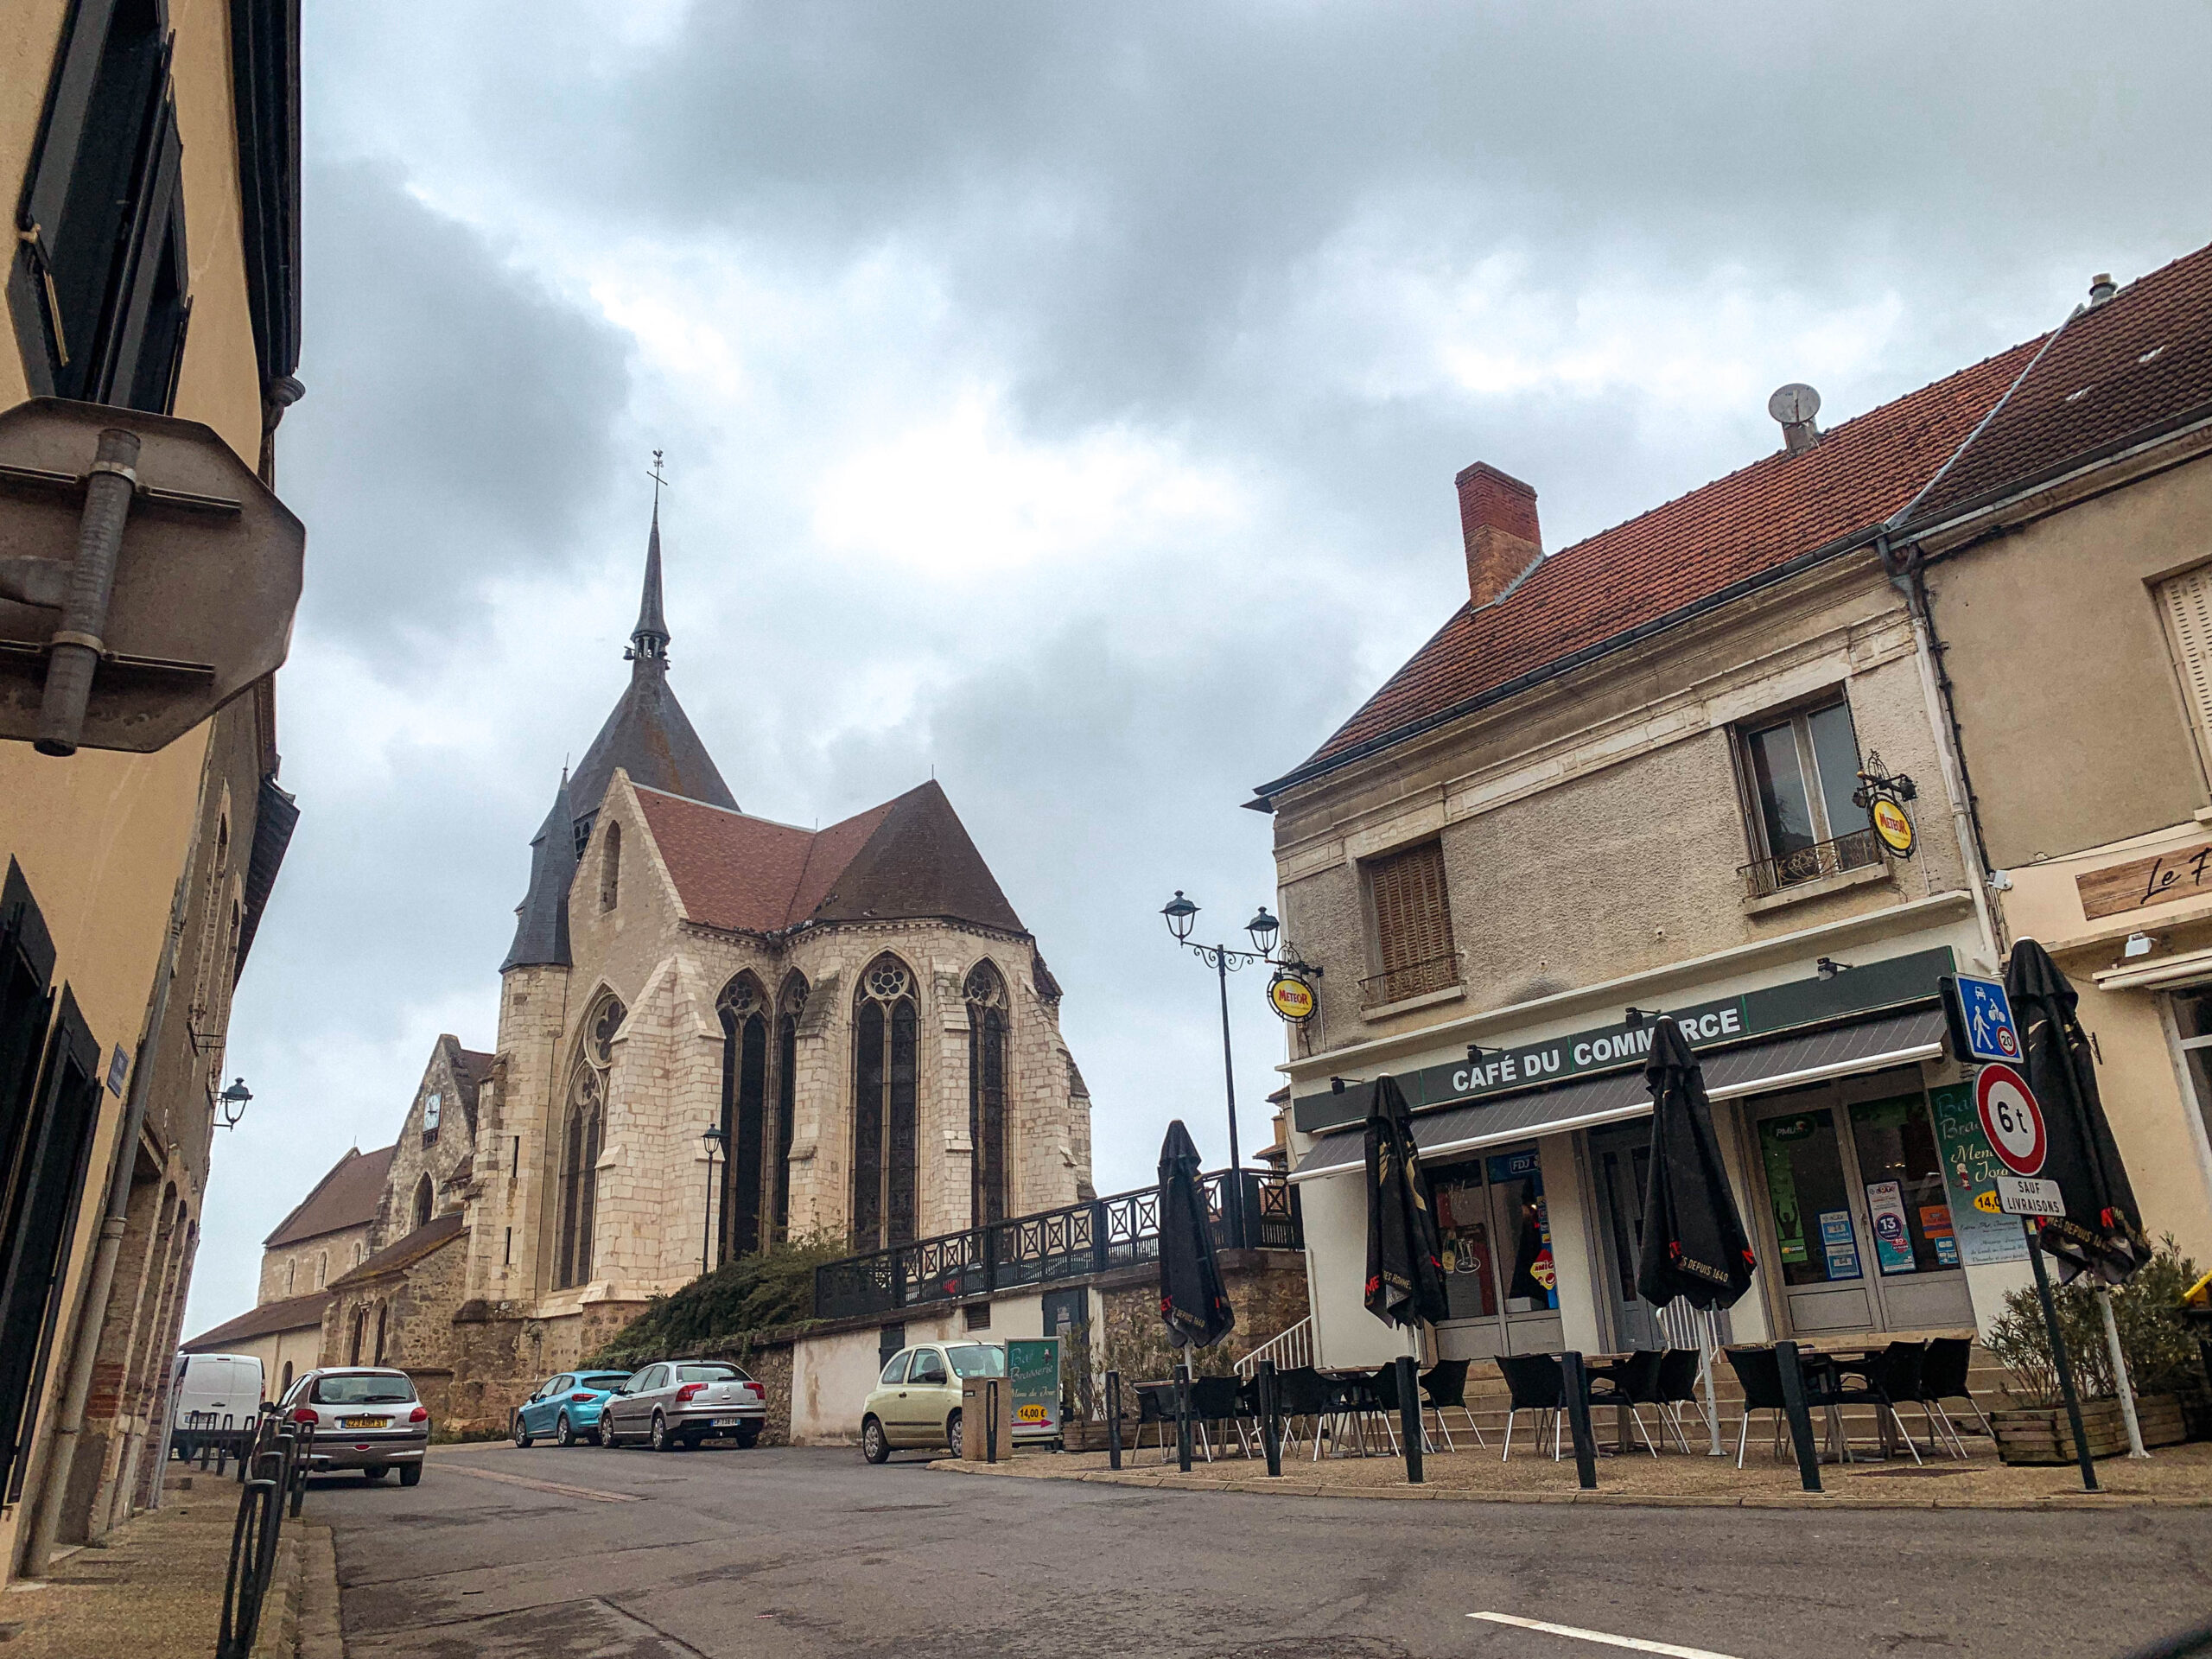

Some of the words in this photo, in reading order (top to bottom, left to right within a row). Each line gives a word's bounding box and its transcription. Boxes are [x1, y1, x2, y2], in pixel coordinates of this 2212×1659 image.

[2140, 857, 2182, 905] Le
[1279, 988, 1309, 1006] METEOR
[2000, 1035, 2012, 1047] 20
[1452, 1054, 1517, 1092] CAFÉ
[1523, 1048, 1560, 1077] DU
[1573, 1007, 1741, 1066] COMMRCE
[1777, 1127, 1796, 1137] PMU
[1513, 1160, 1529, 1171] FDJ
[2018, 1180, 2040, 1195] SAUF
[2006, 1197, 2060, 1214] LIVRAISONS
[1880, 1217, 1897, 1230] 13
[2063, 1221, 2092, 1243] DEPUIS
[1688, 1259, 1713, 1276] DEPUIS
[1713, 1268, 1729, 1283] 1640
[1020, 1408, 1039, 1420] 14,00
[1040, 1408, 1046, 1418] €
